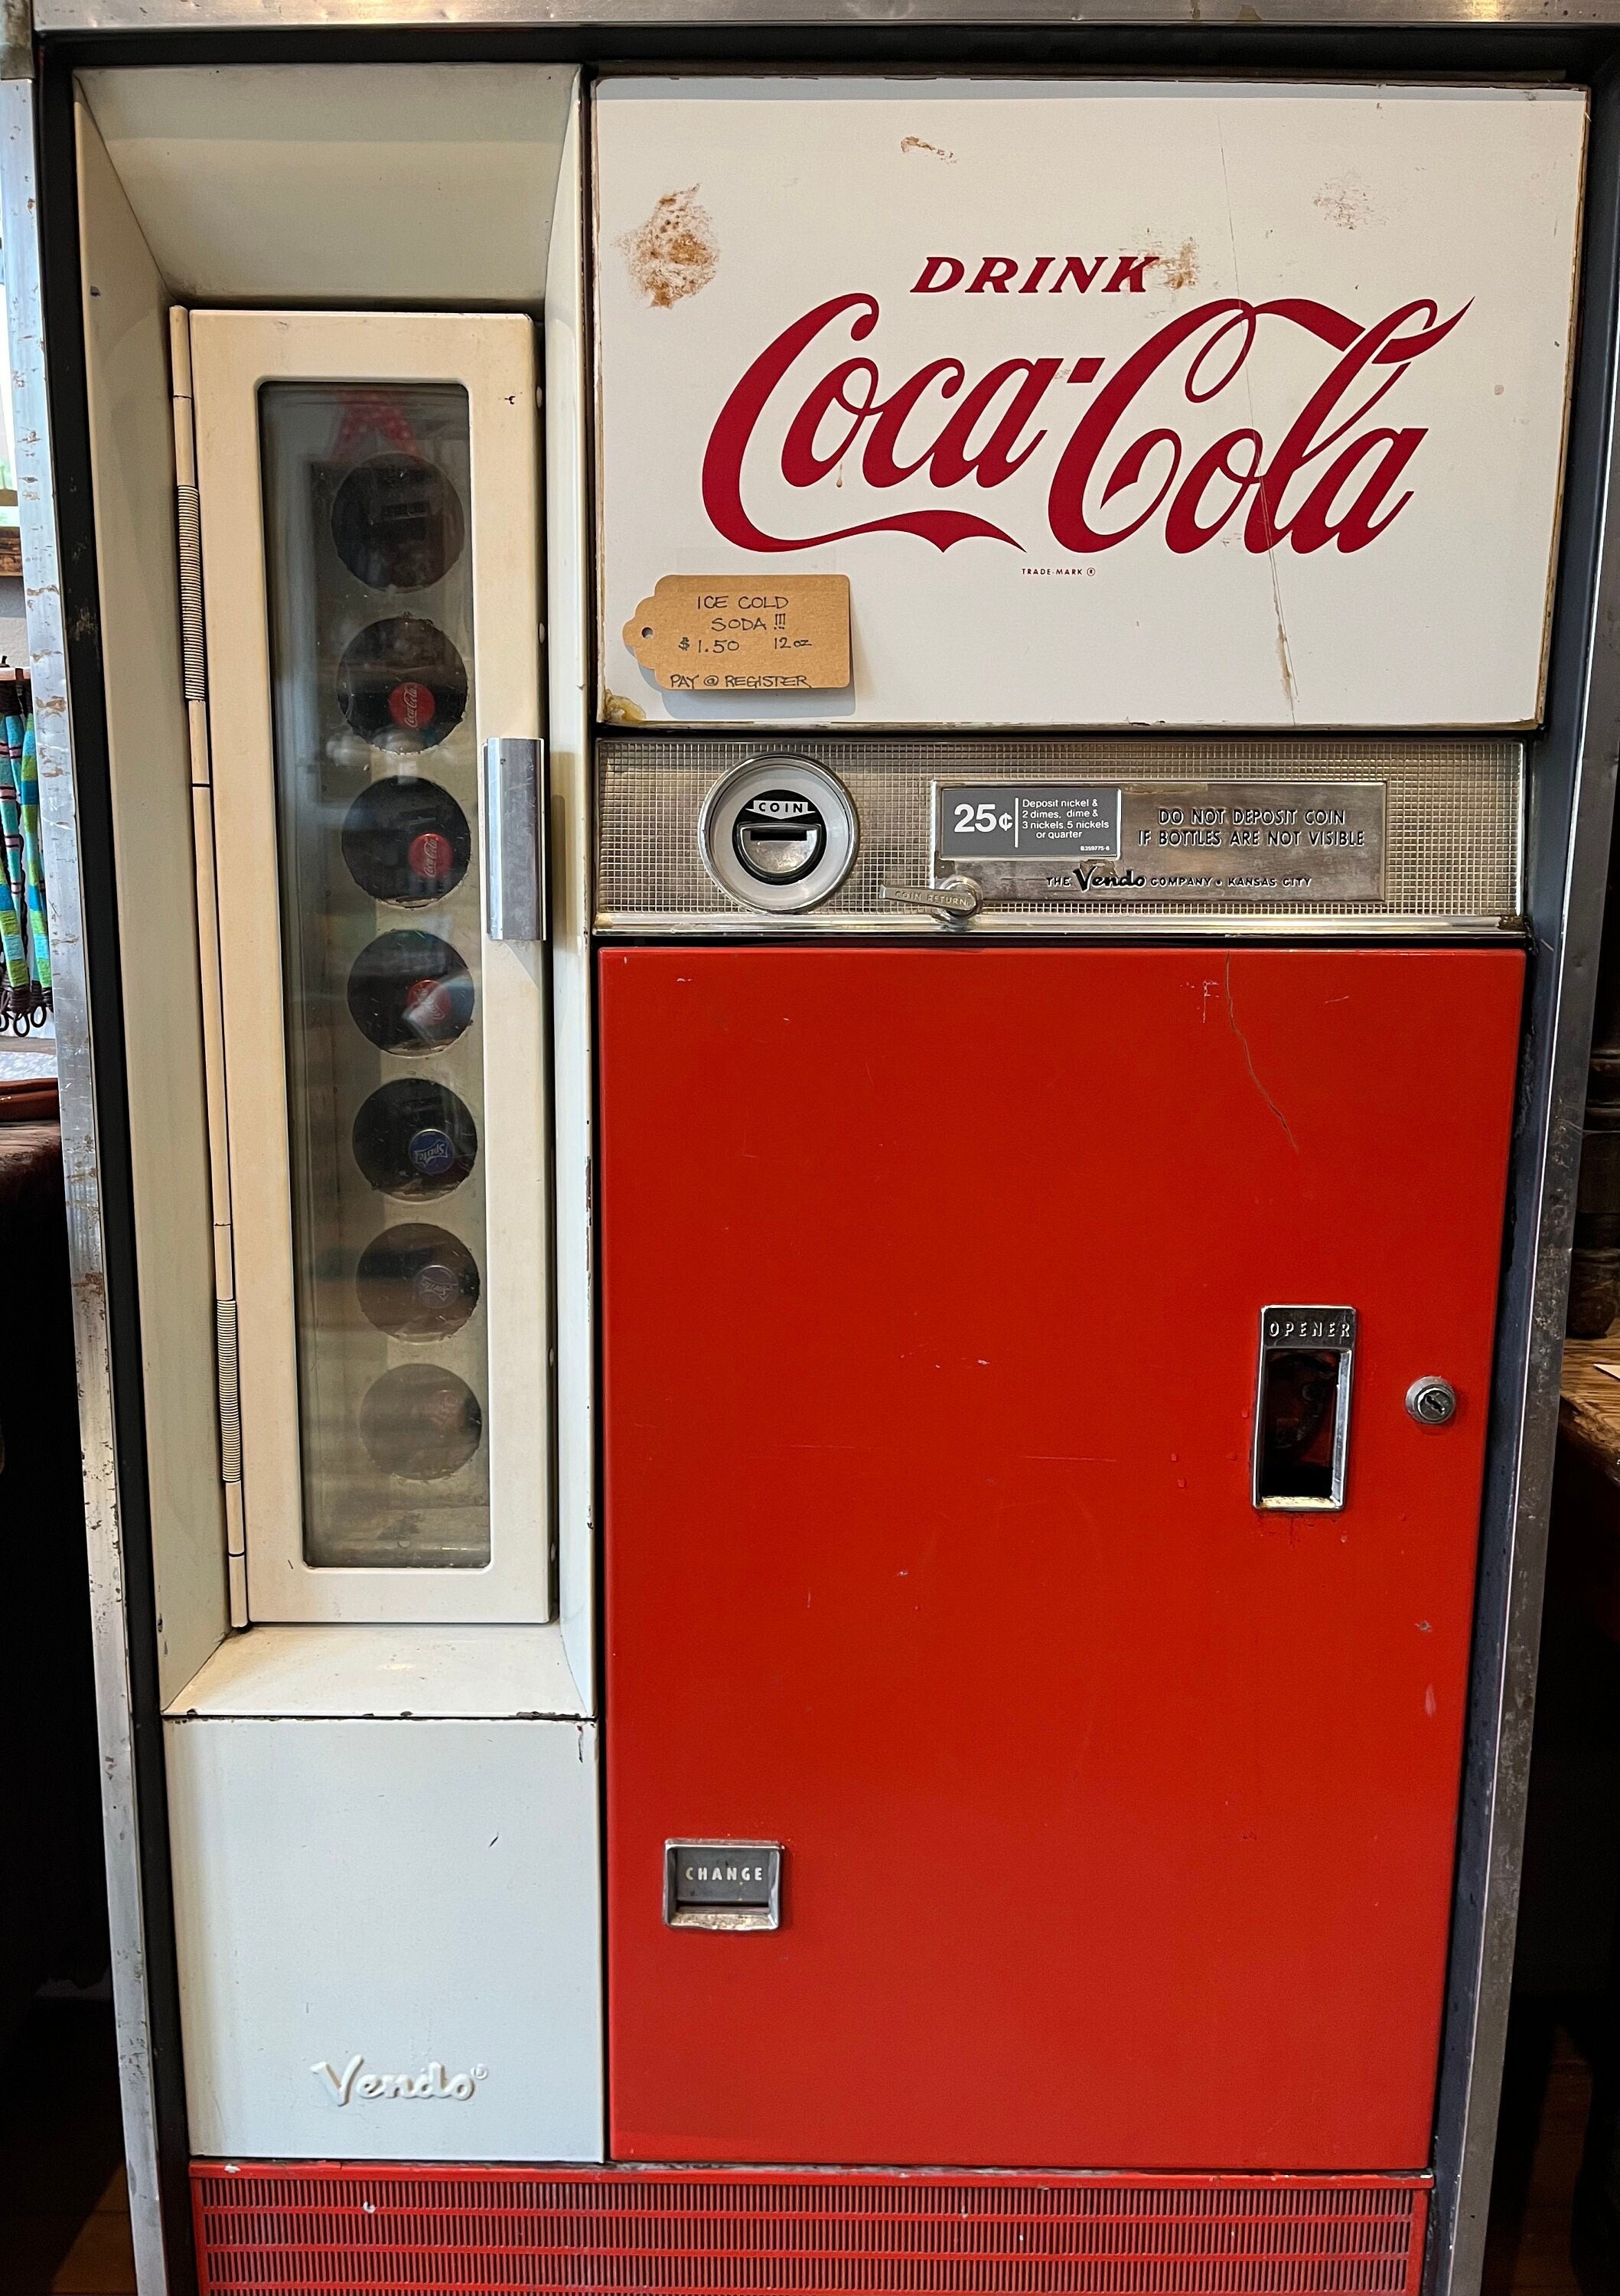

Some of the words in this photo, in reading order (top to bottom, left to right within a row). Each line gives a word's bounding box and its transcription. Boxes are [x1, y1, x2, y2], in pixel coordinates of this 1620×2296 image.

[910, 256, 1160, 293] DRINK
[702, 292, 1476, 555] Coca-Cola
[697, 595, 729, 610] ICE
[738, 595, 789, 610] COLD
[711, 617, 767, 632] SODA
[670, 673, 699, 689] PAY
[725, 674, 812, 689] REGISTER
[758, 802, 803, 814] COIN
[1022, 798, 1058, 809] Deposit
[1061, 798, 1089, 807] nickel
[1091, 798, 1098, 807] &
[953, 804, 1013, 833] 25¢
[1022, 810, 1028, 818] 2
[1066, 809, 1090, 817] dime
[1092, 809, 1098, 817] &
[1159, 807, 1184, 825] DO
[1191, 808, 1226, 825] NOT
[1233, 809, 1298, 826] DEPOSIT
[1304, 809, 1345, 826] COIN
[1022, 820, 1028, 830] 3
[1067, 820, 1074, 829] 5
[1076, 820, 1110, 829] nickels
[1048, 830, 1082, 840] quarter
[1138, 830, 1152, 846] IF
[1158, 830, 1222, 847] BOTTLES
[1229, 830, 1260, 846] ARE
[1267, 830, 1301, 846] NOT
[1308, 830, 1365, 846] VISIBLE
[1046, 877, 1071, 887] THE
[1071, 866, 1147, 892] Vendo
[1150, 877, 1213, 888] COMPANY
[1227, 877, 1277, 888] KANSAS
[1283, 878, 1312, 888] CITY
[895, 890, 922, 900] COIN
[927, 895, 966, 905] RETURN
[1270, 1322, 1350, 1337] OPENER
[686, 1867, 762, 1880] CHANGE
